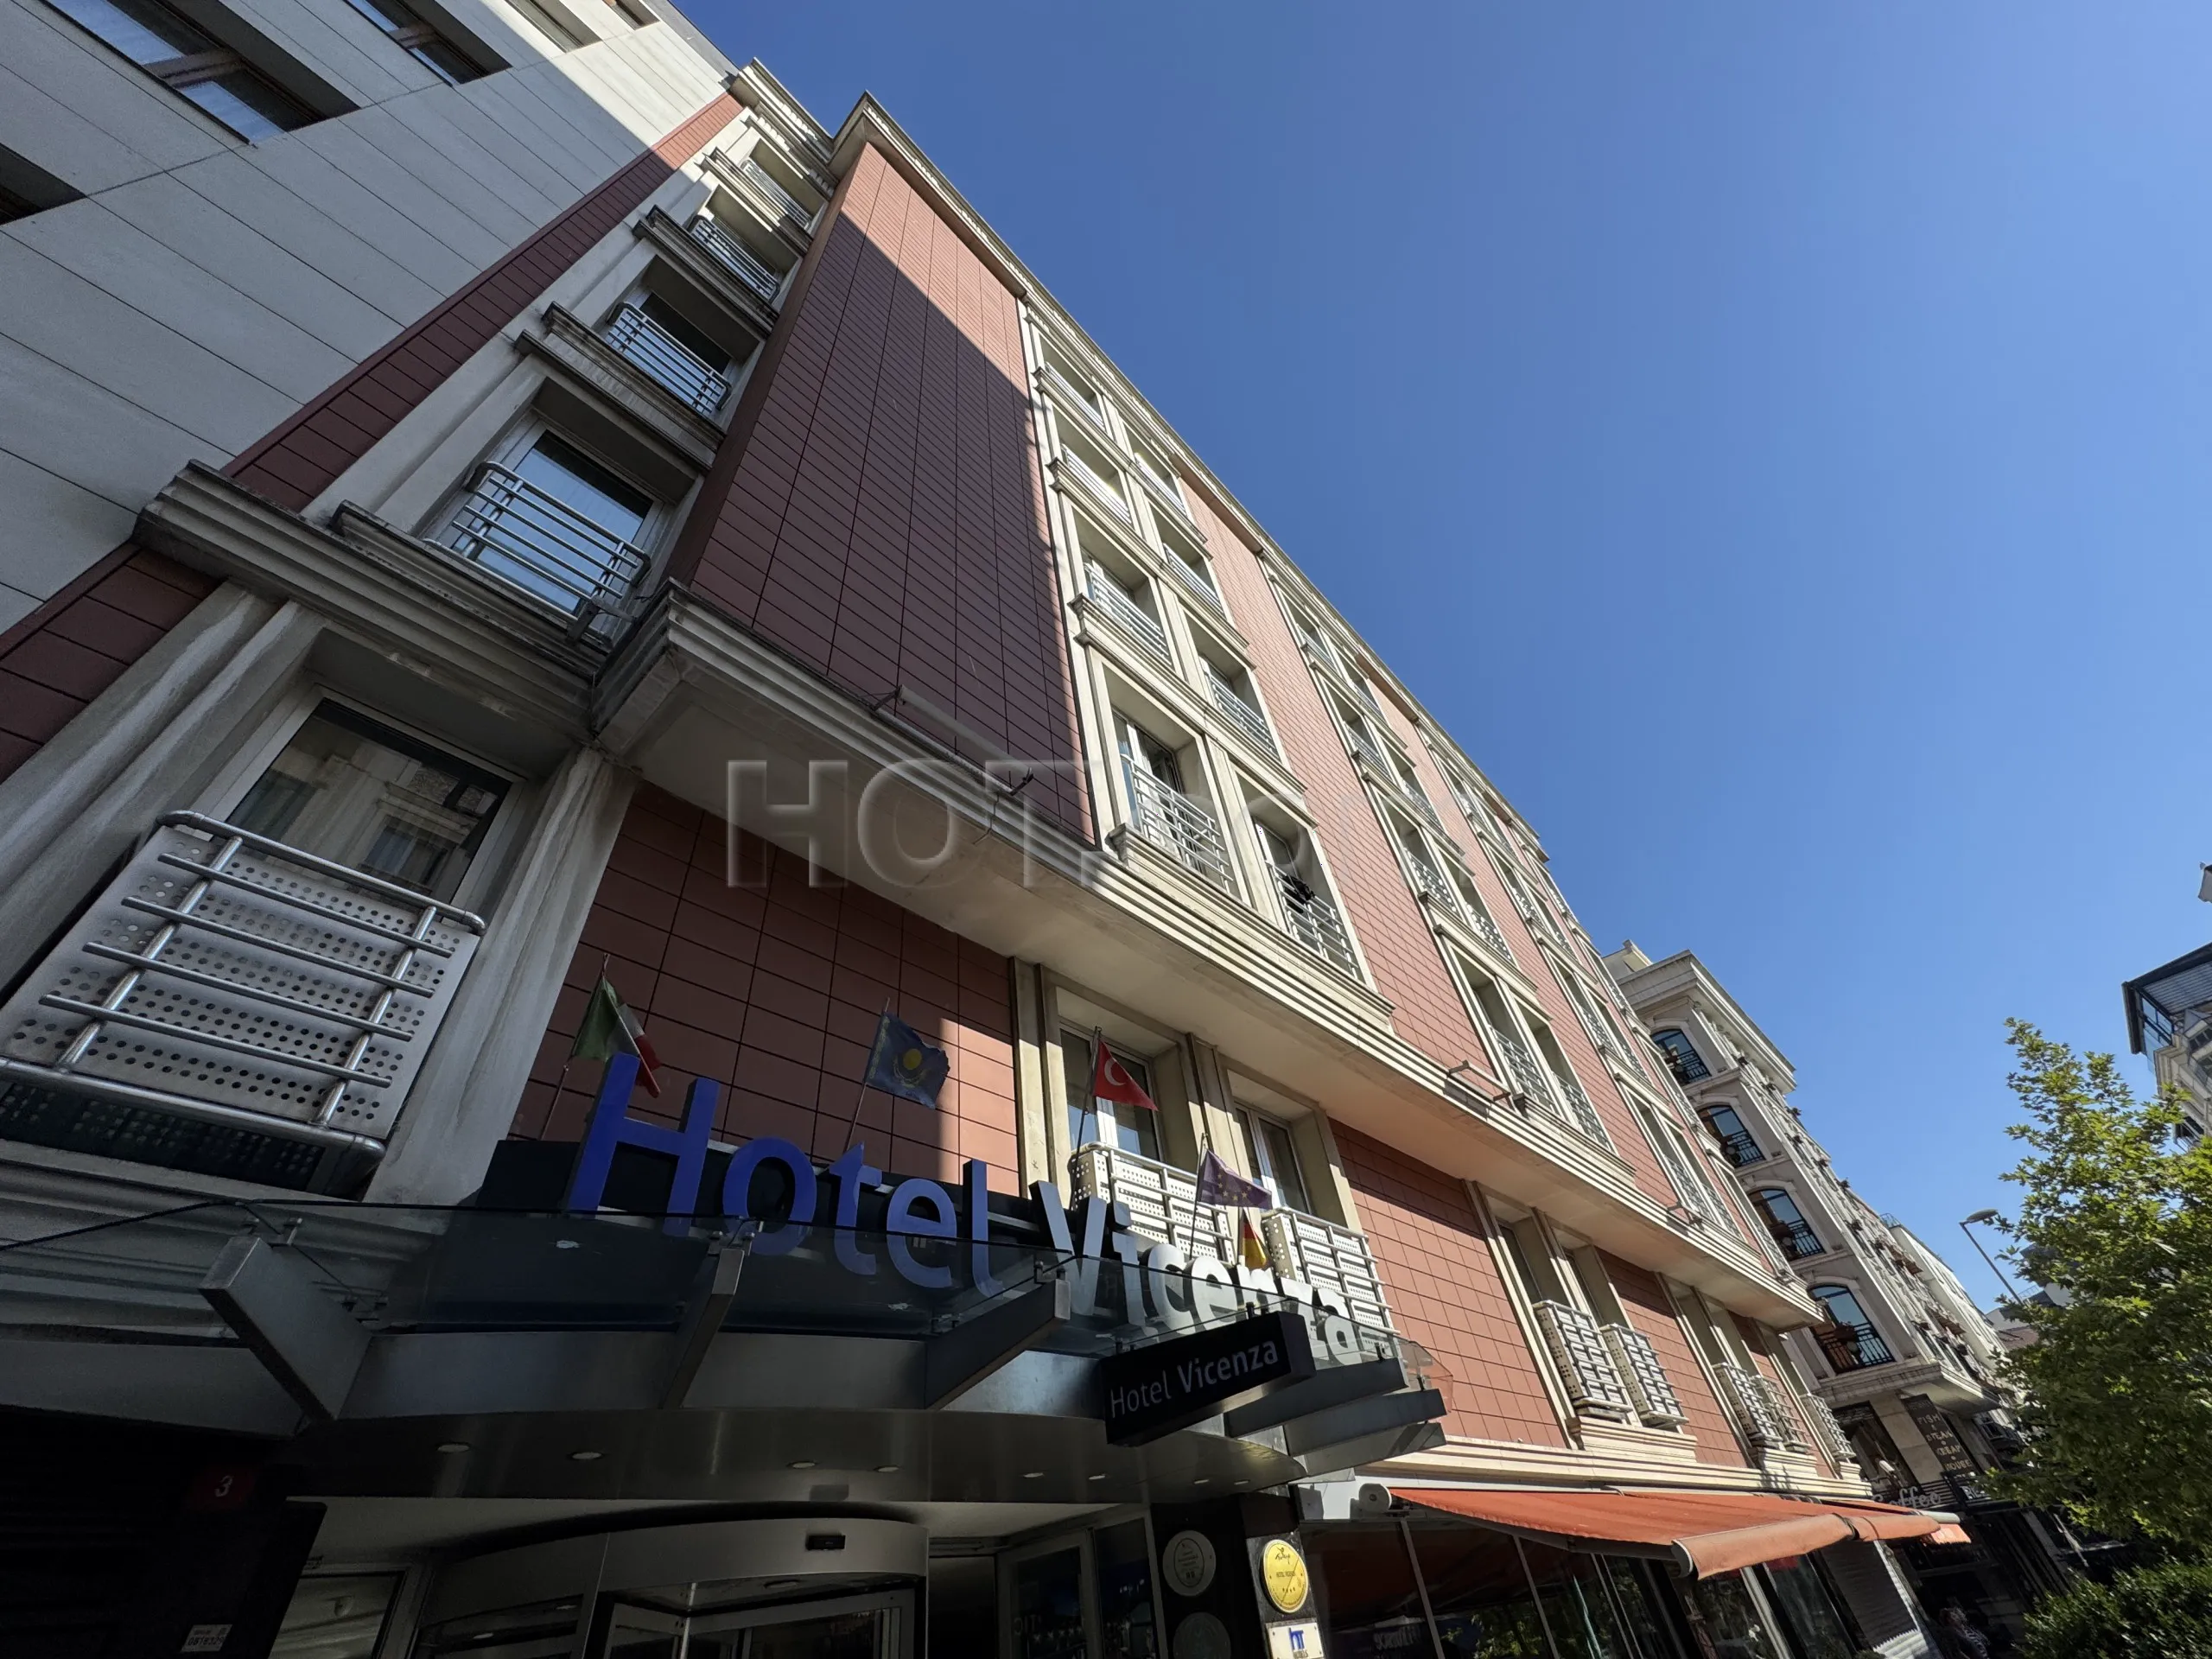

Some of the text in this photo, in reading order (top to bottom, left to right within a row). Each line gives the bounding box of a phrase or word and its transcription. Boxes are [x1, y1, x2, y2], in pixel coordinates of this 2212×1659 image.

[566, 1051, 1006, 1299] Hotel
[1110, 1340, 1279, 1418] Hotel Vicenza
[1916, 1414, 1941, 1425] FISH
[1926, 1431, 1954, 1442] STEAK
[1944, 1459, 1973, 1471] HOUSE
[213, 1474, 234, 1498] 3
